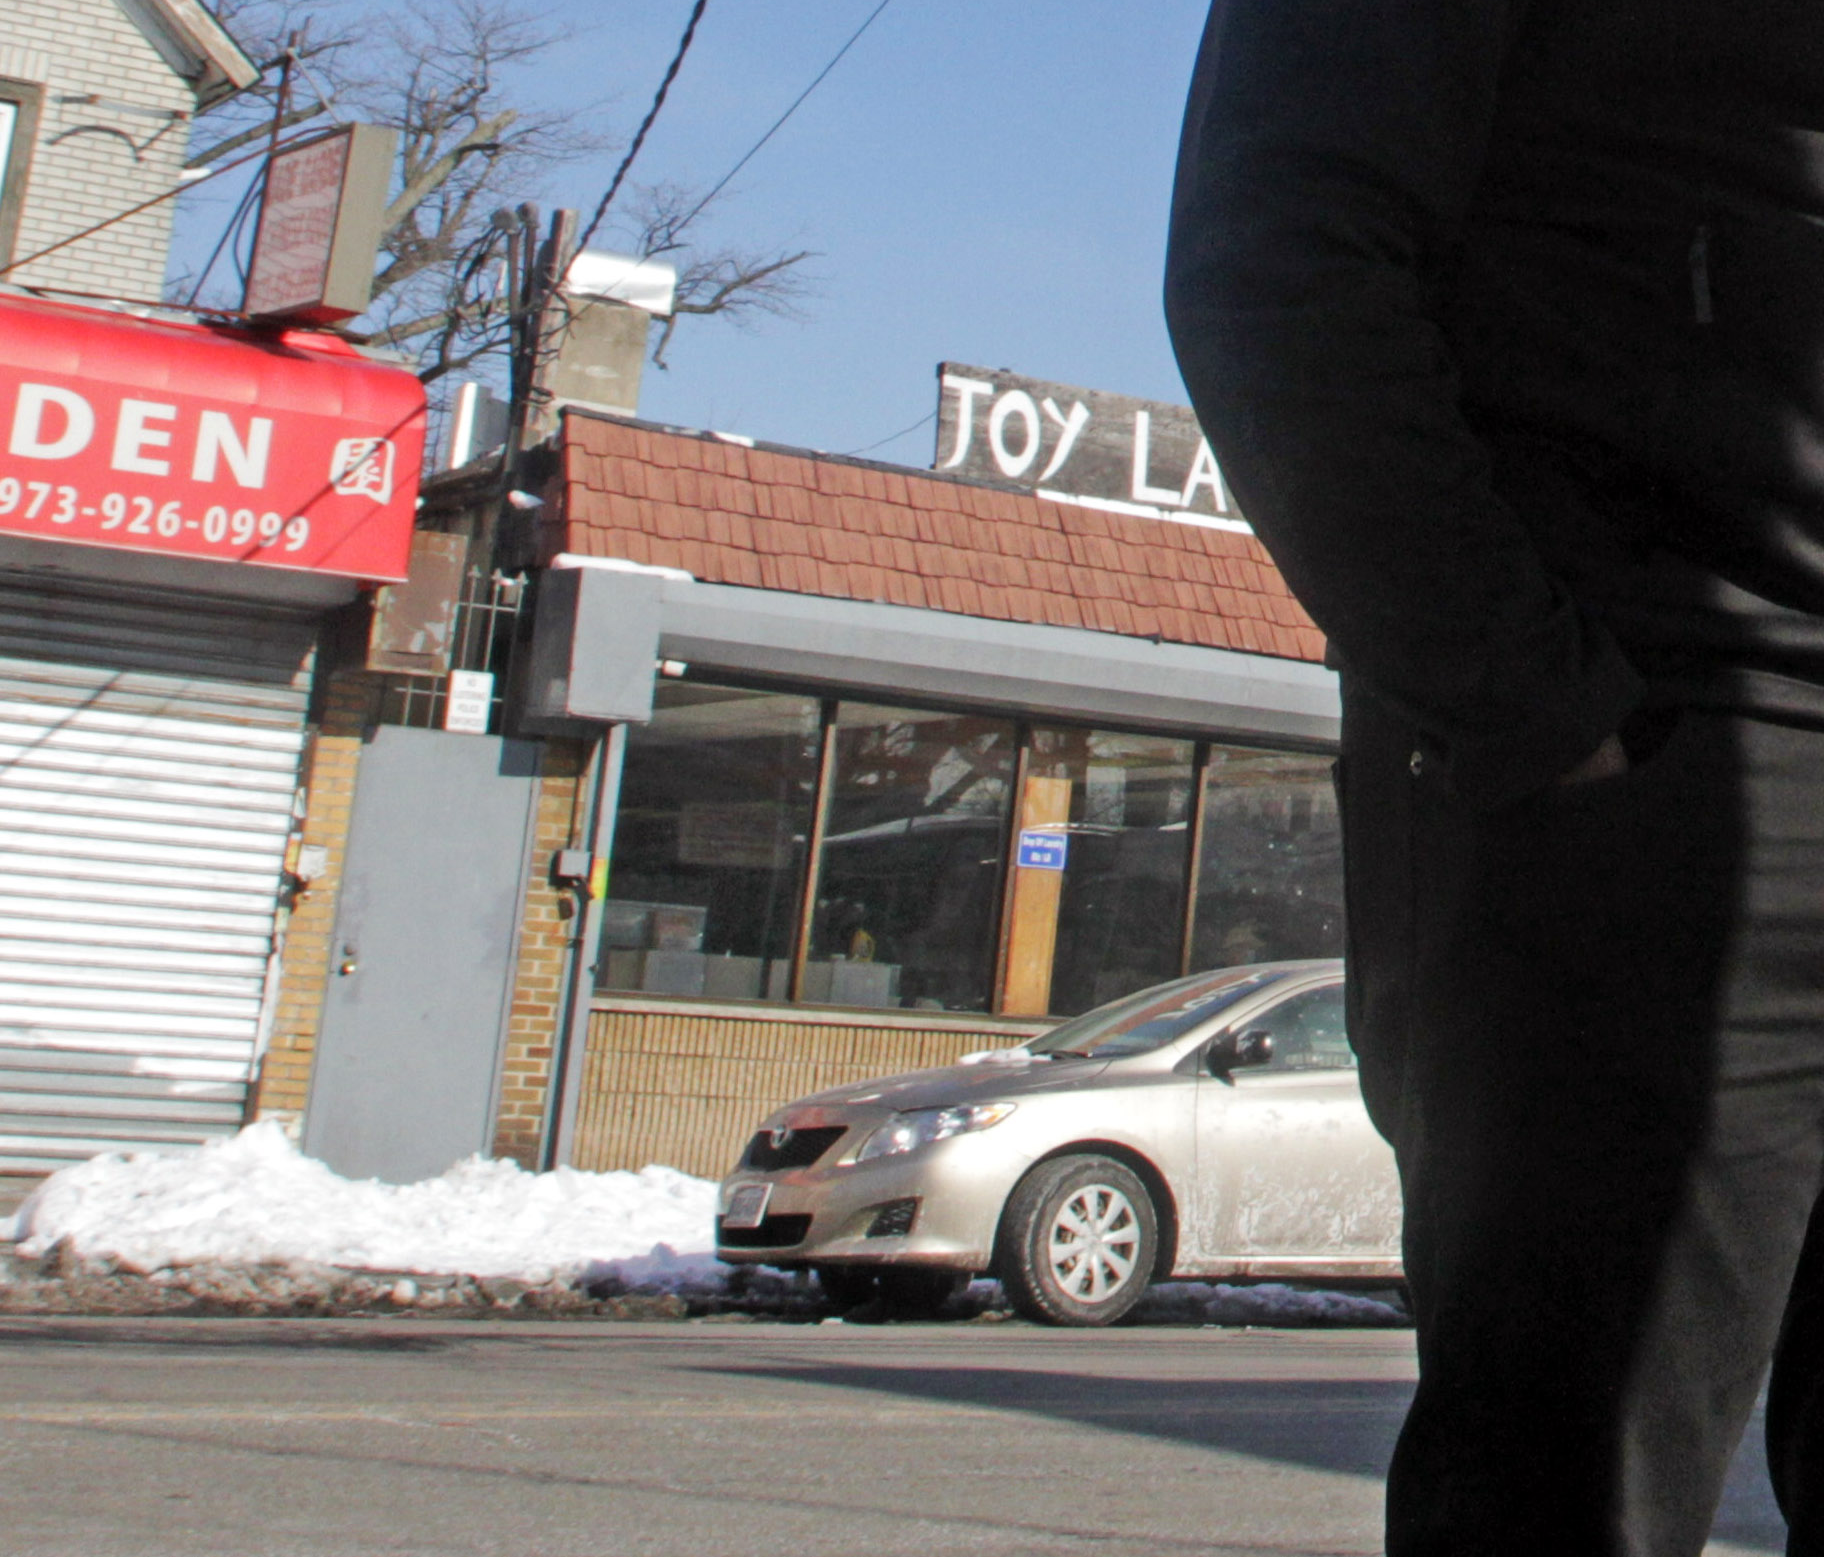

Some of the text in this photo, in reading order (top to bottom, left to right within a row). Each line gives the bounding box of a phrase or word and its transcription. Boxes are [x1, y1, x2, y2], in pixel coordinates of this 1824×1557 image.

[8, 382, 274, 490] DEN
[943, 373, 1091, 483] JOY
[0, 477, 310, 552] 973-926-0999
